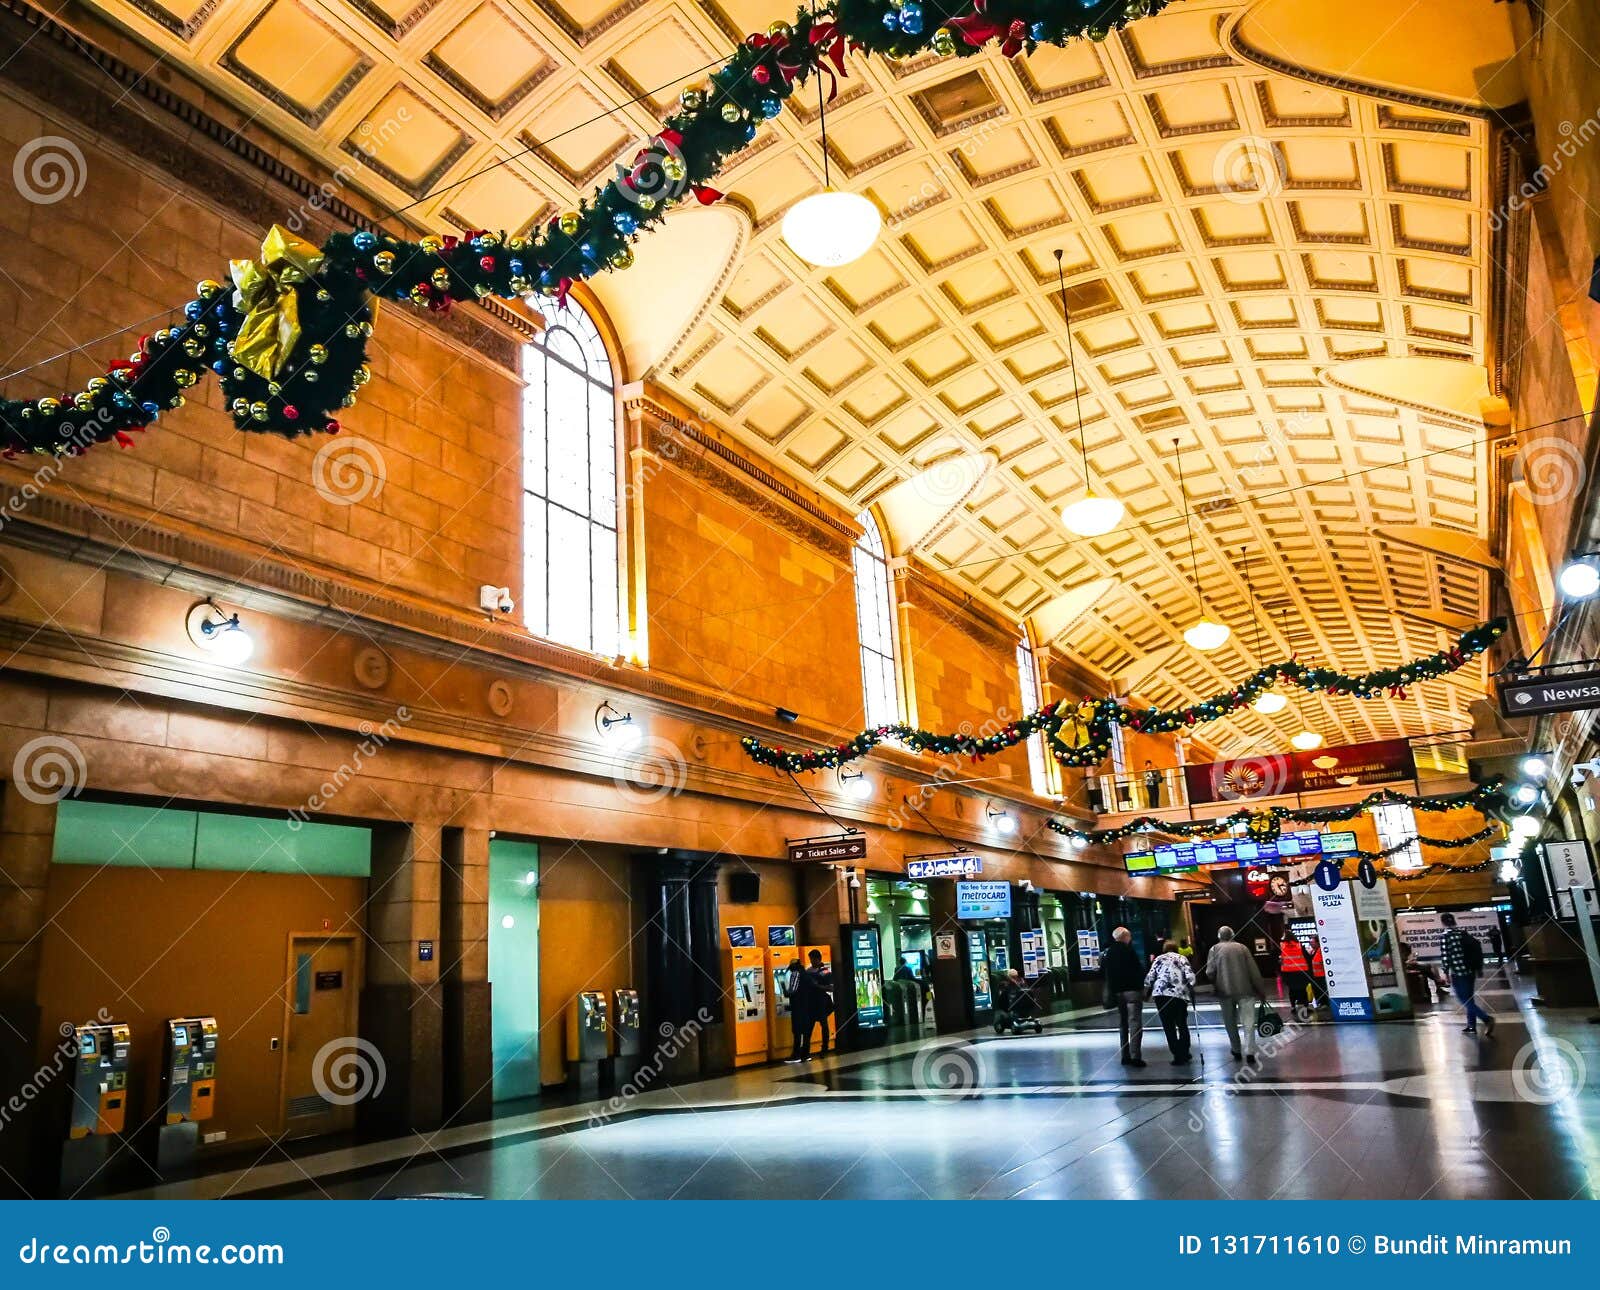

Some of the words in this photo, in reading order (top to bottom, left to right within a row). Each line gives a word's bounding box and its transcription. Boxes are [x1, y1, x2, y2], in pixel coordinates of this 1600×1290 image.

[1218, 781, 1265, 792] ADELAIDE
[807, 849, 828, 857] Ticket
[828, 847, 846, 856] Sales
[1563, 848, 1576, 877] CASINO
[1291, 922, 1316, 930] ACCESS
